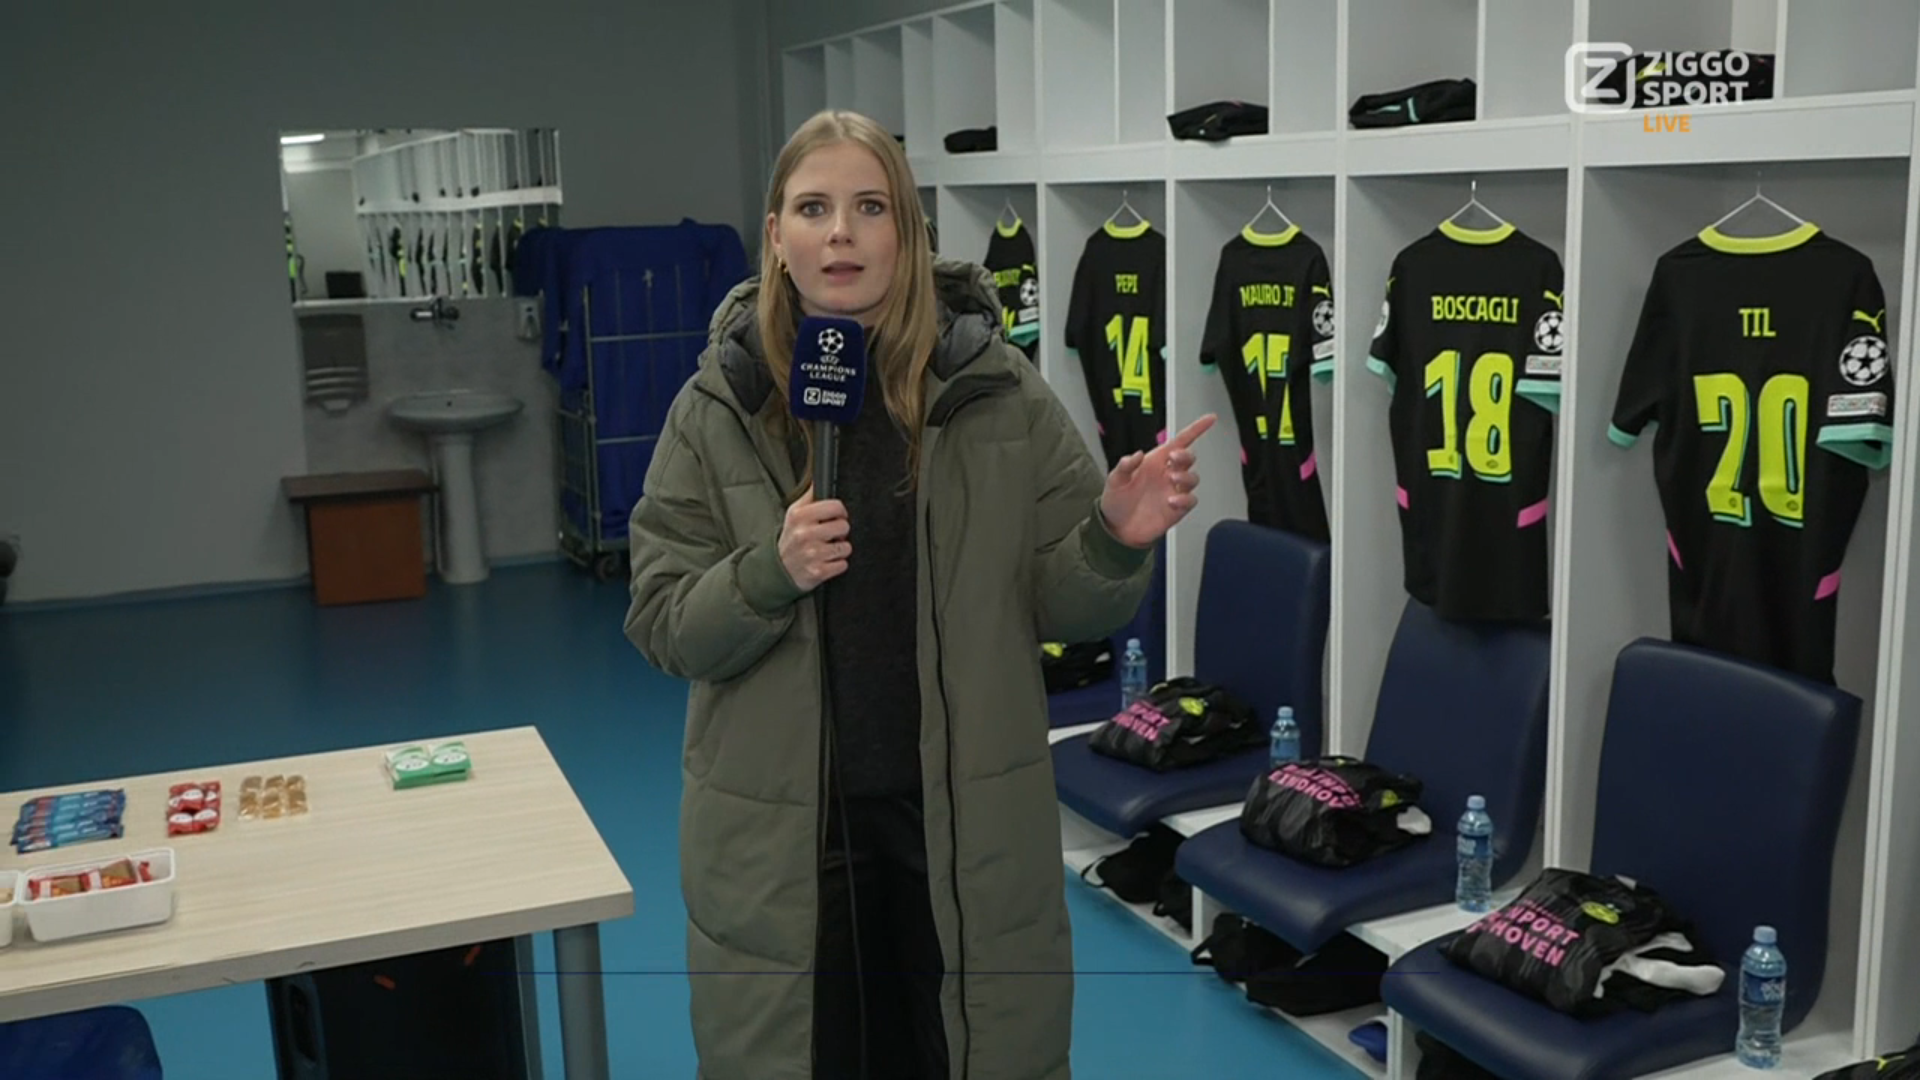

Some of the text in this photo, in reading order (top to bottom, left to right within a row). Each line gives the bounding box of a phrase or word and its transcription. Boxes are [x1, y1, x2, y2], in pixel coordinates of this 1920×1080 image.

[1115, 274, 1138, 294] PEPI
[1239, 284, 1282, 308] MAURO
[1431, 296, 1519, 324] BOSCAGLI
[1739, 308, 1776, 338] TIL
[800, 362, 857, 376] CHAMPIONS
[809, 371, 847, 382] LEAGUE
[1105, 314, 1153, 414] 14
[1241, 332, 1296, 445] 17
[1424, 350, 1514, 483] 18
[1694, 373, 1810, 528] 20
